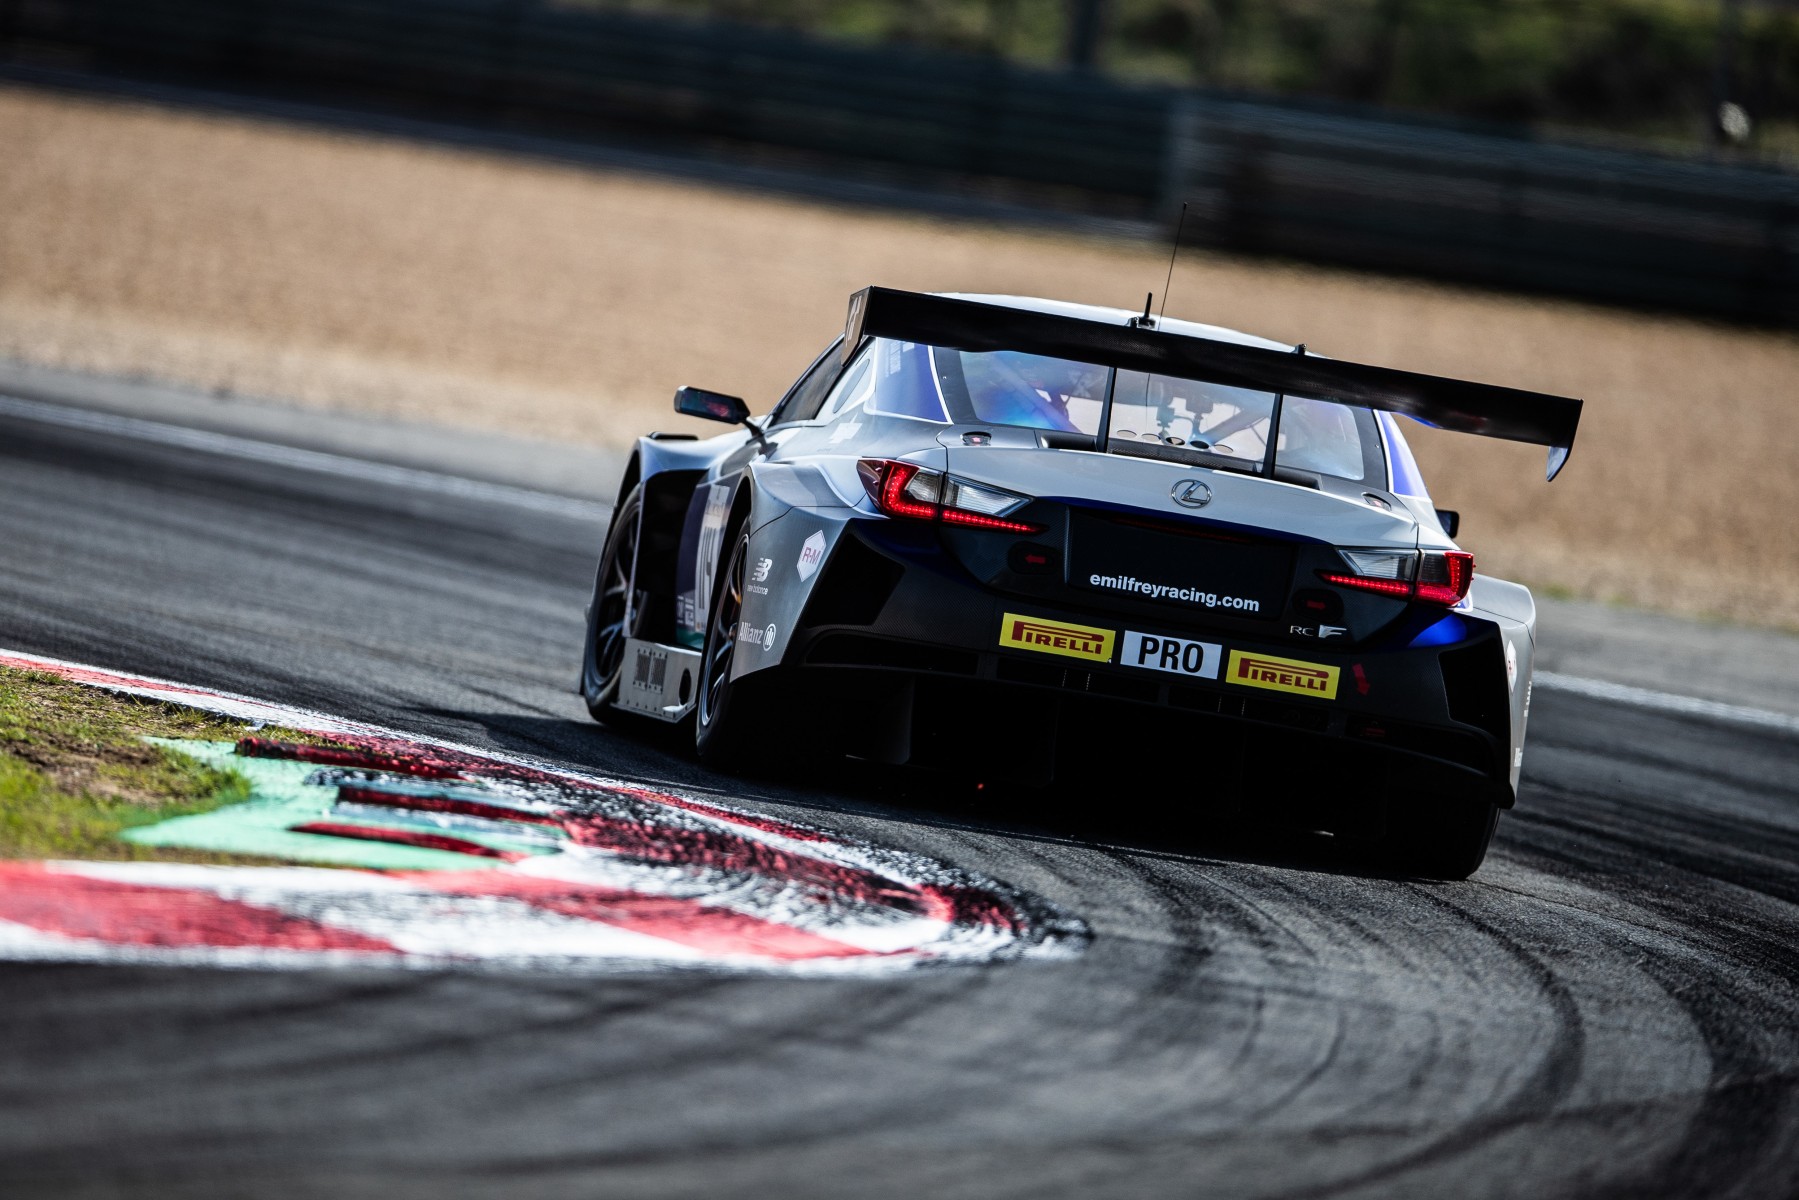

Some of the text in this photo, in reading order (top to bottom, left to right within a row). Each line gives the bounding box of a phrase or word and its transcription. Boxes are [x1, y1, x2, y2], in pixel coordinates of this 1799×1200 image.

[1089, 573, 1260, 612] emilfreyracing.com
[738, 622, 764, 644] Allianz
[1011, 620, 1105, 655] PIRELLI
[1289, 625, 1315, 637] RC
[1137, 635, 1204, 674] PRO
[1237, 657, 1330, 692] PIRELLI
